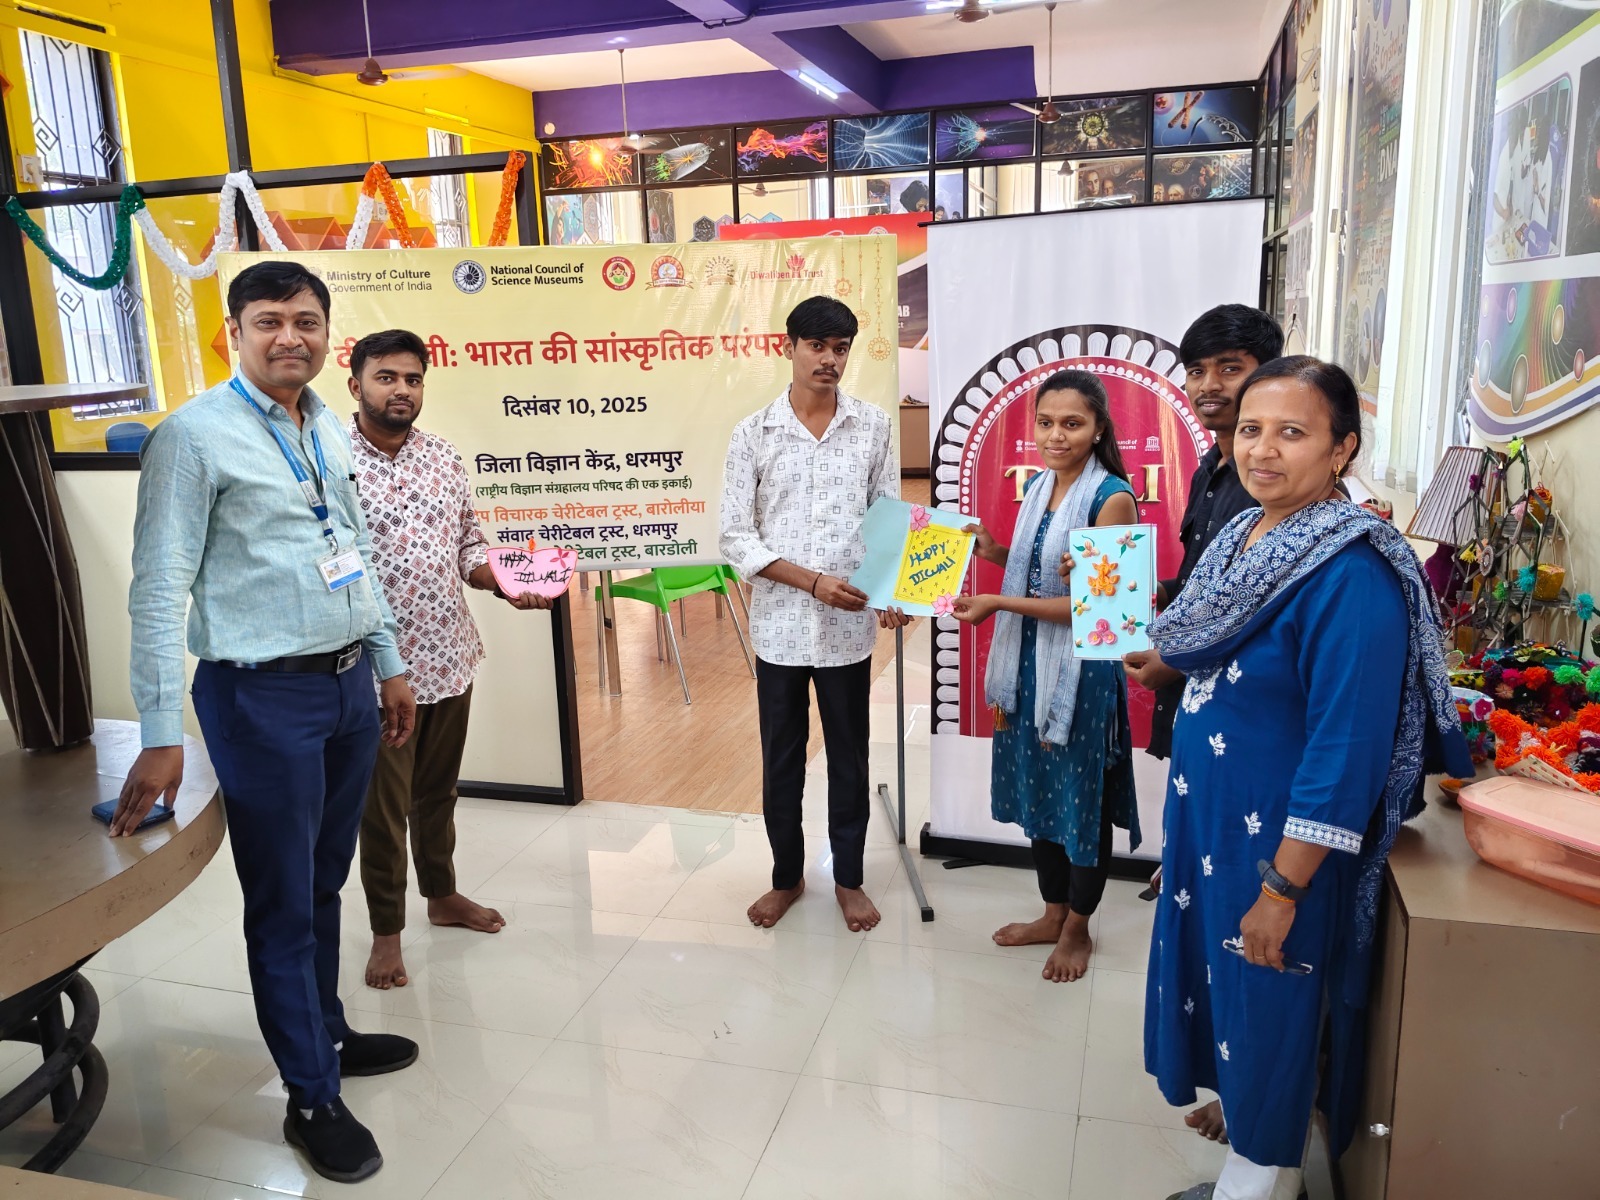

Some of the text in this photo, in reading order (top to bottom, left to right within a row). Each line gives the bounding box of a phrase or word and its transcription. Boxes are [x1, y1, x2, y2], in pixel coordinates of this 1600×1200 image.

[1379, 138, 1398, 183] DNA
[326, 269, 431, 282] Ministry of Culture
[490, 263, 584, 276] National Council of
[491, 274, 584, 286] Science Museums
[750, 269, 823, 279] Diwaliben Trust
[329, 281, 432, 293] Government of India
[464, 341, 534, 367] भारत
[540, 331, 577, 364] की
[584, 329, 714, 371] सांस्कृतिक
[720, 327, 787, 359] परंपर
[502, 395, 647, 418] दिसंबर 10, 2025
[475, 449, 684, 475] जिला विज्ञान केंद्र, धरमपुर
[475, 475, 693, 499] (राष्ट्रीय विज्ञान संग्रहालय परिषद की एक इकाई)
[493, 506, 548, 522] विचारक
[551, 501, 608, 520] चेरीटेबल
[611, 503, 642, 520] ट्रस्ट,
[645, 498, 706, 516] बारोलीया
[497, 522, 679, 543] संवाद चेरीटेबल ट्रस्ट, धरमपुर
[611, 545, 641, 562] ट्रस्ट,
[644, 538, 698, 557] बारडोली
